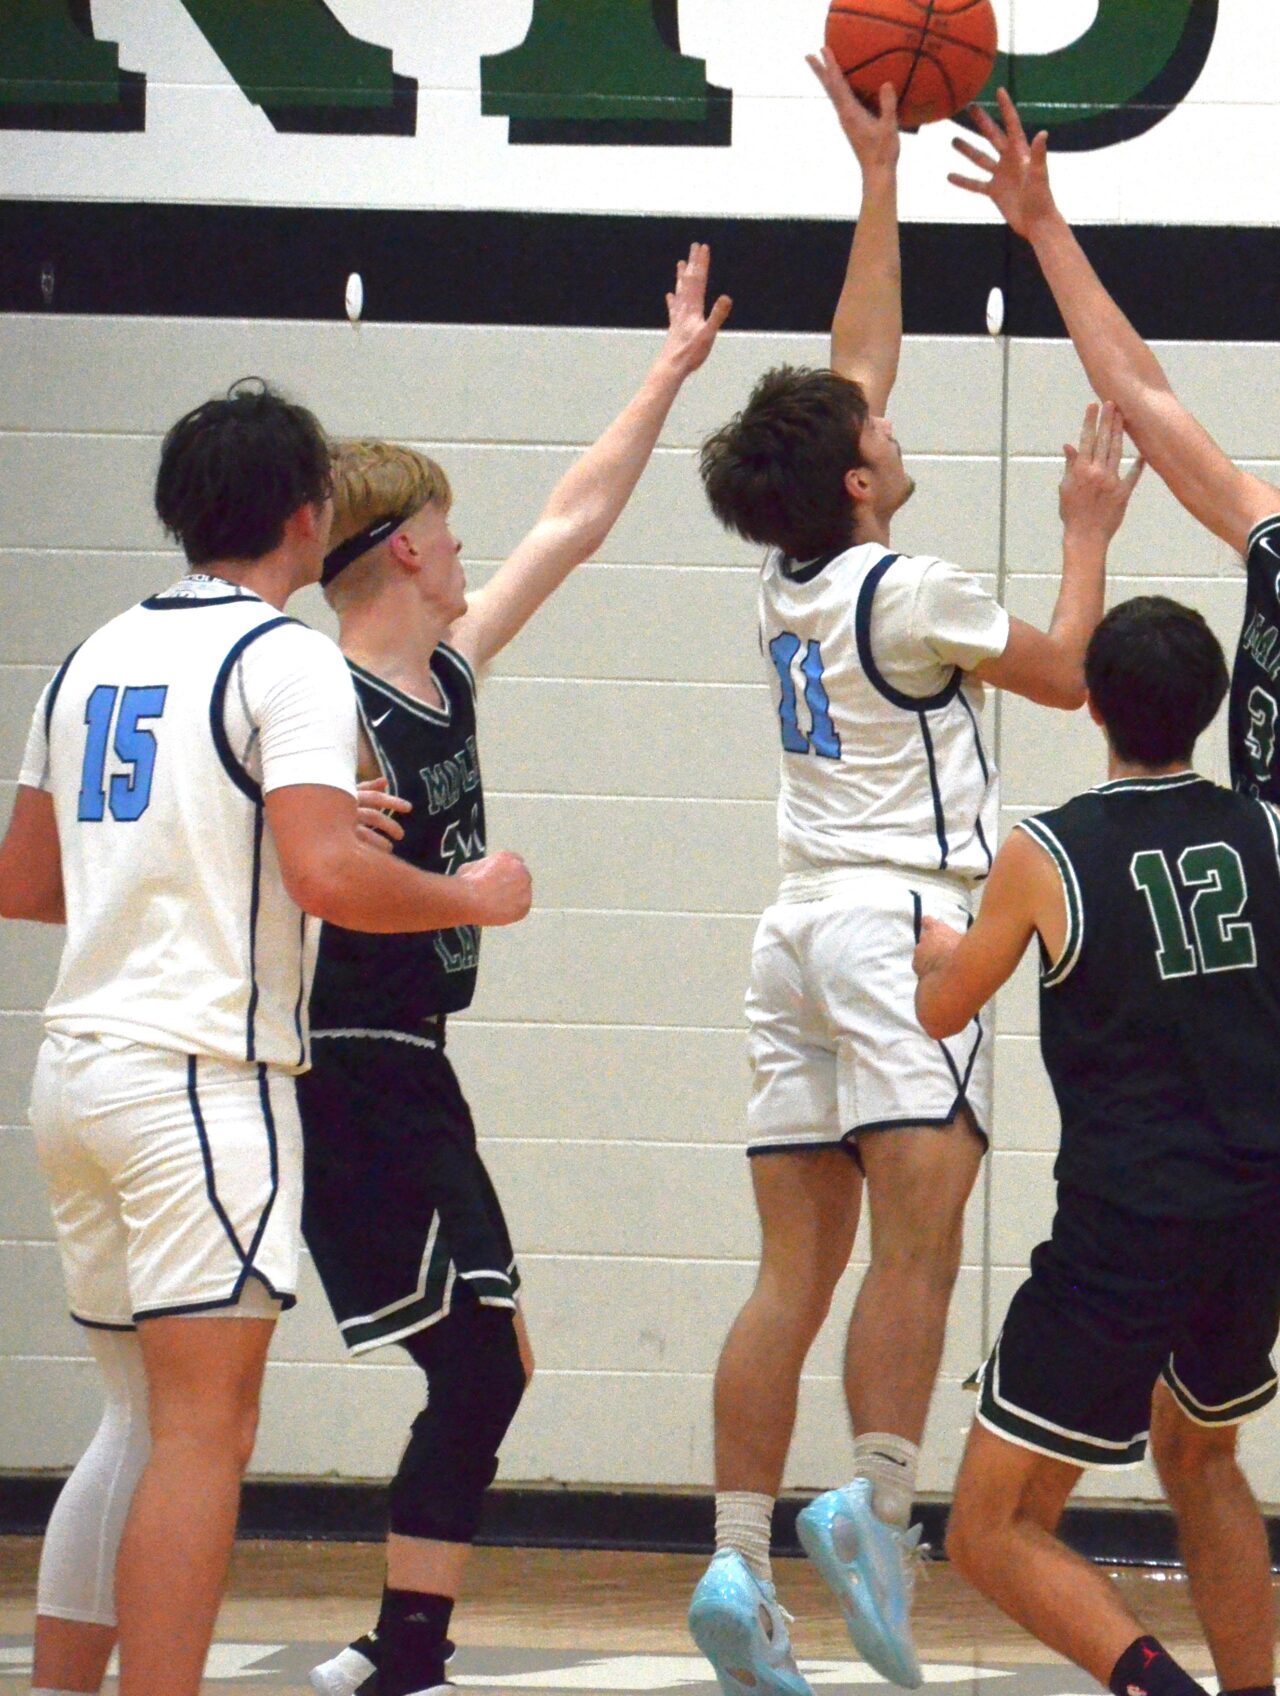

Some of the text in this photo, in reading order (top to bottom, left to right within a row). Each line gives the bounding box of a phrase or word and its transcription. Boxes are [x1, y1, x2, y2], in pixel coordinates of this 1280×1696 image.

[77, 684, 169, 822] 15
[769, 630, 842, 760] 11
[1244, 685, 1279, 782] 3
[1129, 841, 1258, 980] 12
